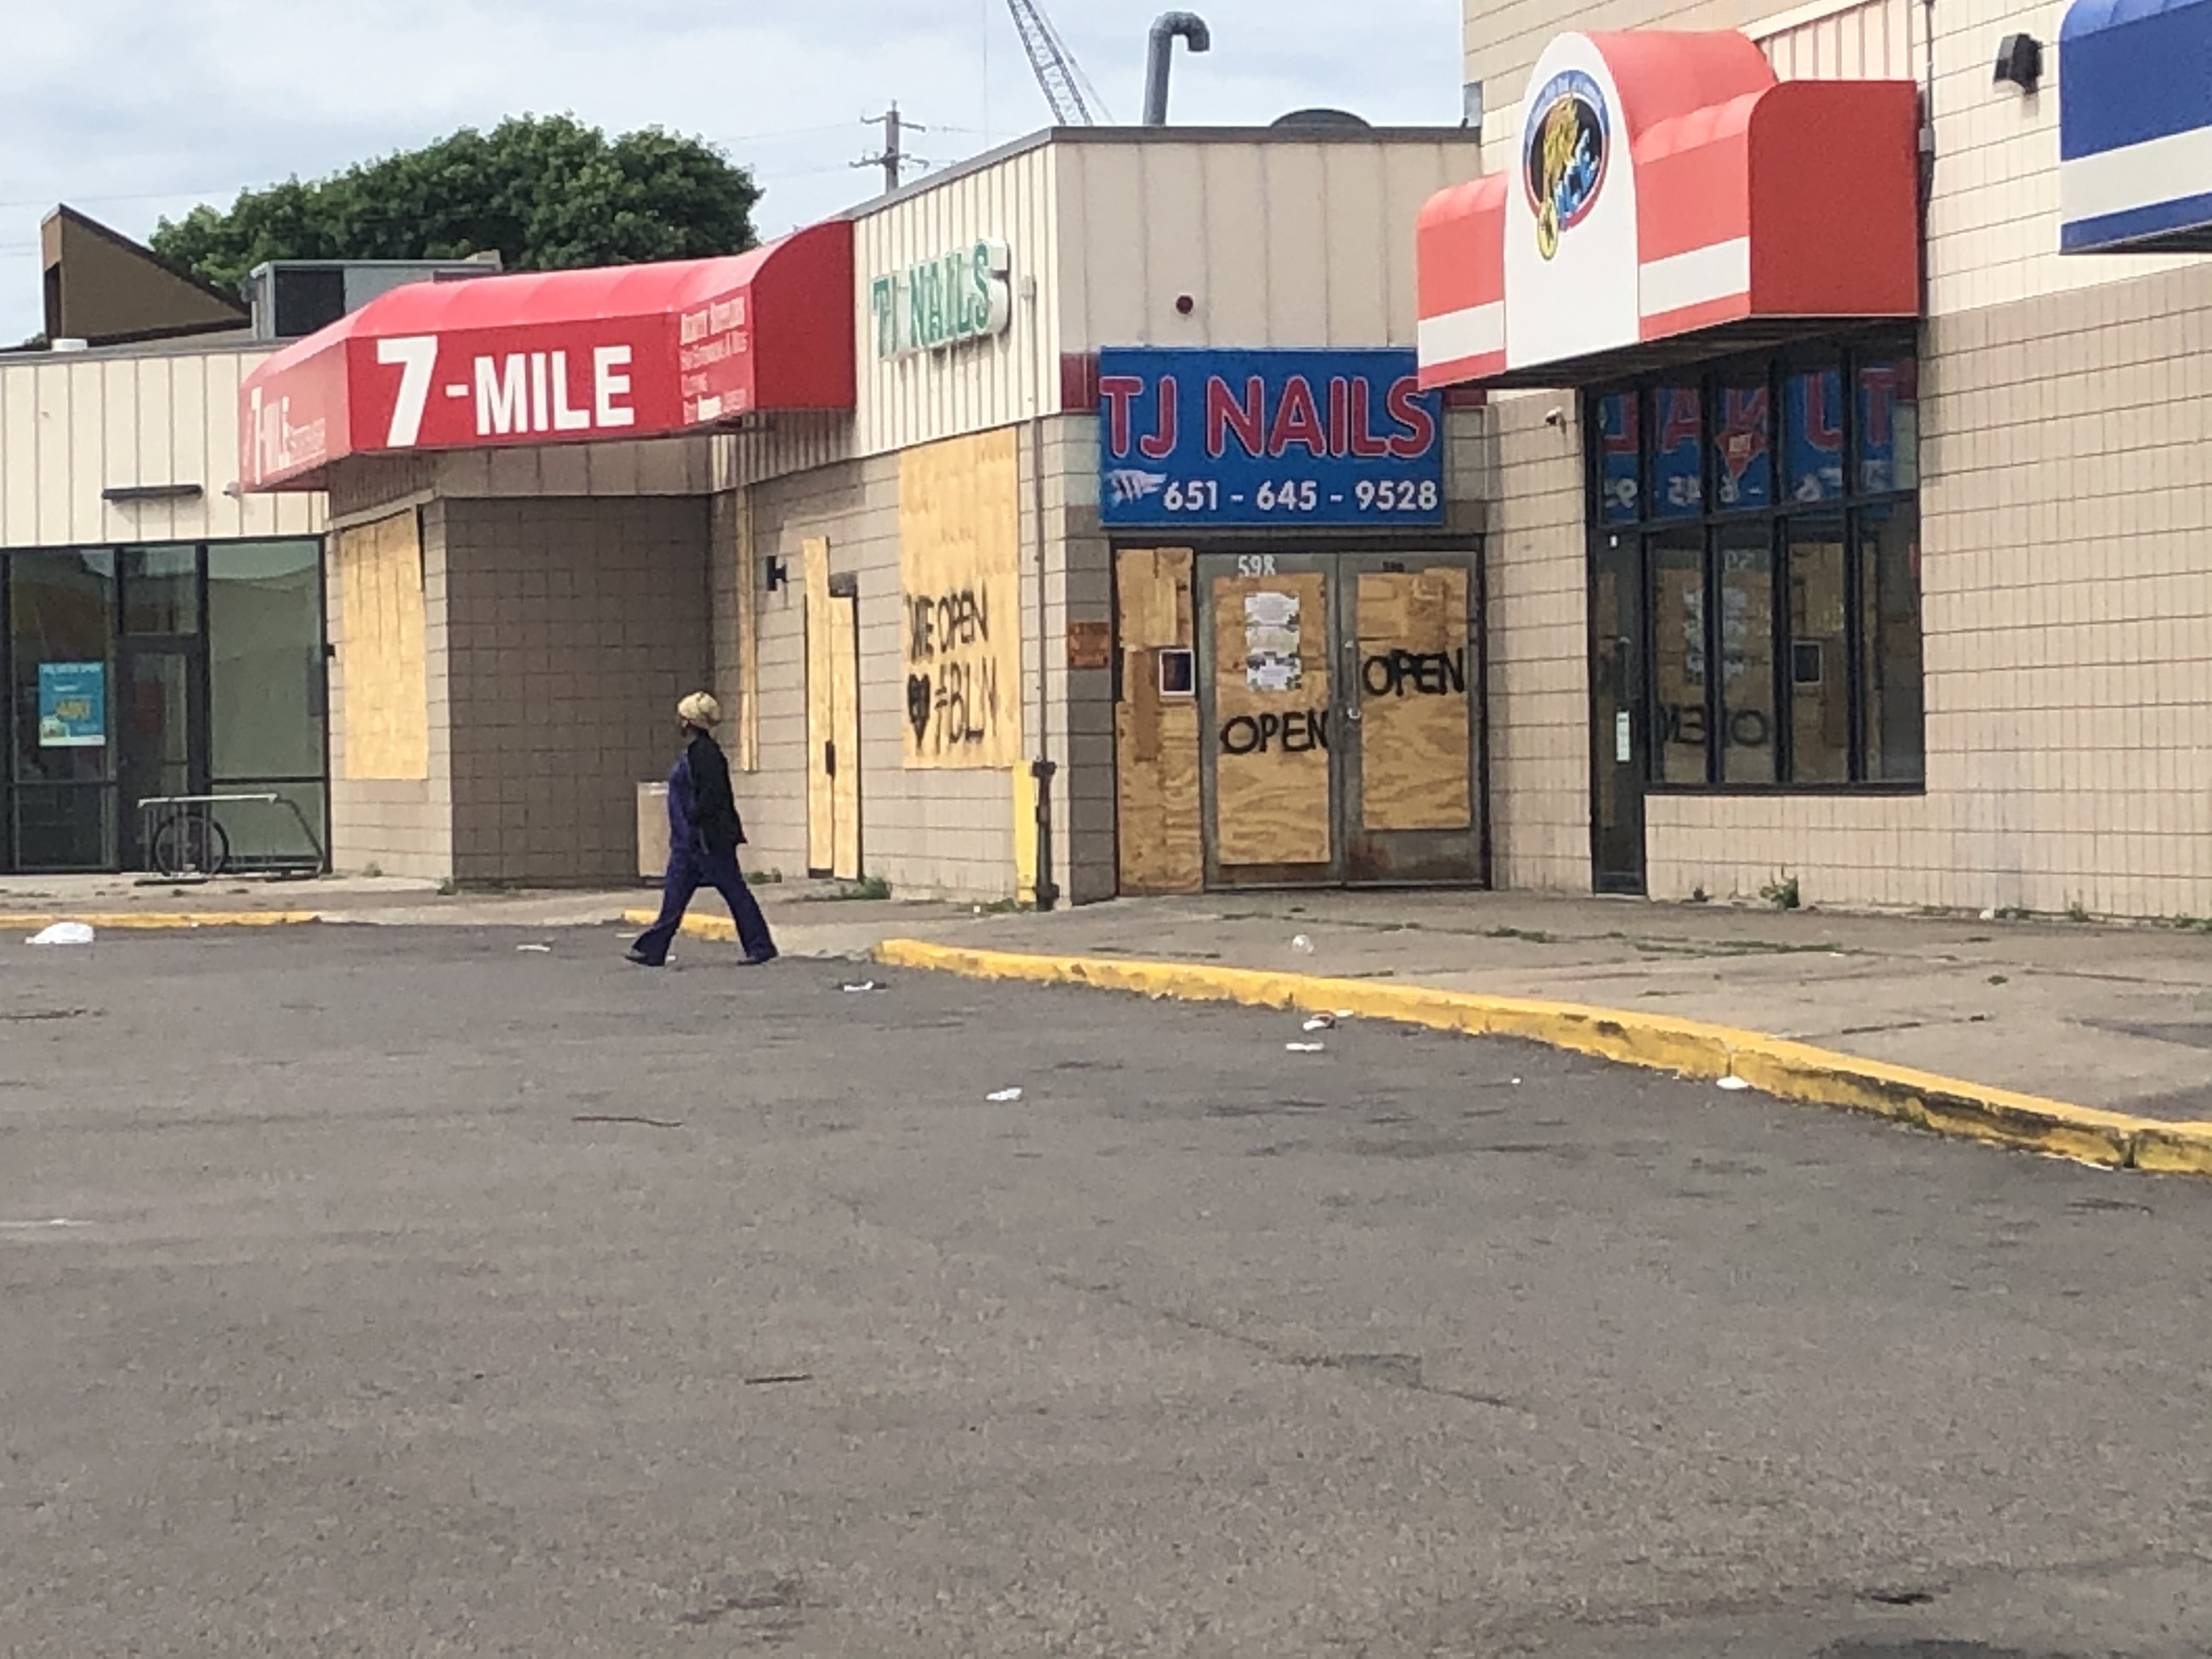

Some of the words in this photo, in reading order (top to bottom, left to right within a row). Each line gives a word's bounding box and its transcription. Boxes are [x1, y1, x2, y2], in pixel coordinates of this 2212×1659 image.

[909, 240, 990, 348] NAILS
[1098, 374, 1177, 458] TJ
[1205, 374, 1436, 459] NAILS
[1163, 479, 1218, 511] 651
[1256, 479, 1318, 511] 645
[1355, 479, 1438, 511] 9528
[1238, 555, 1276, 578] 598
[904, 592, 934, 664] WE
[938, 579, 988, 654] OPEN
[1362, 647, 1465, 697] OPEN
[1220, 708, 1329, 754] OPEN
